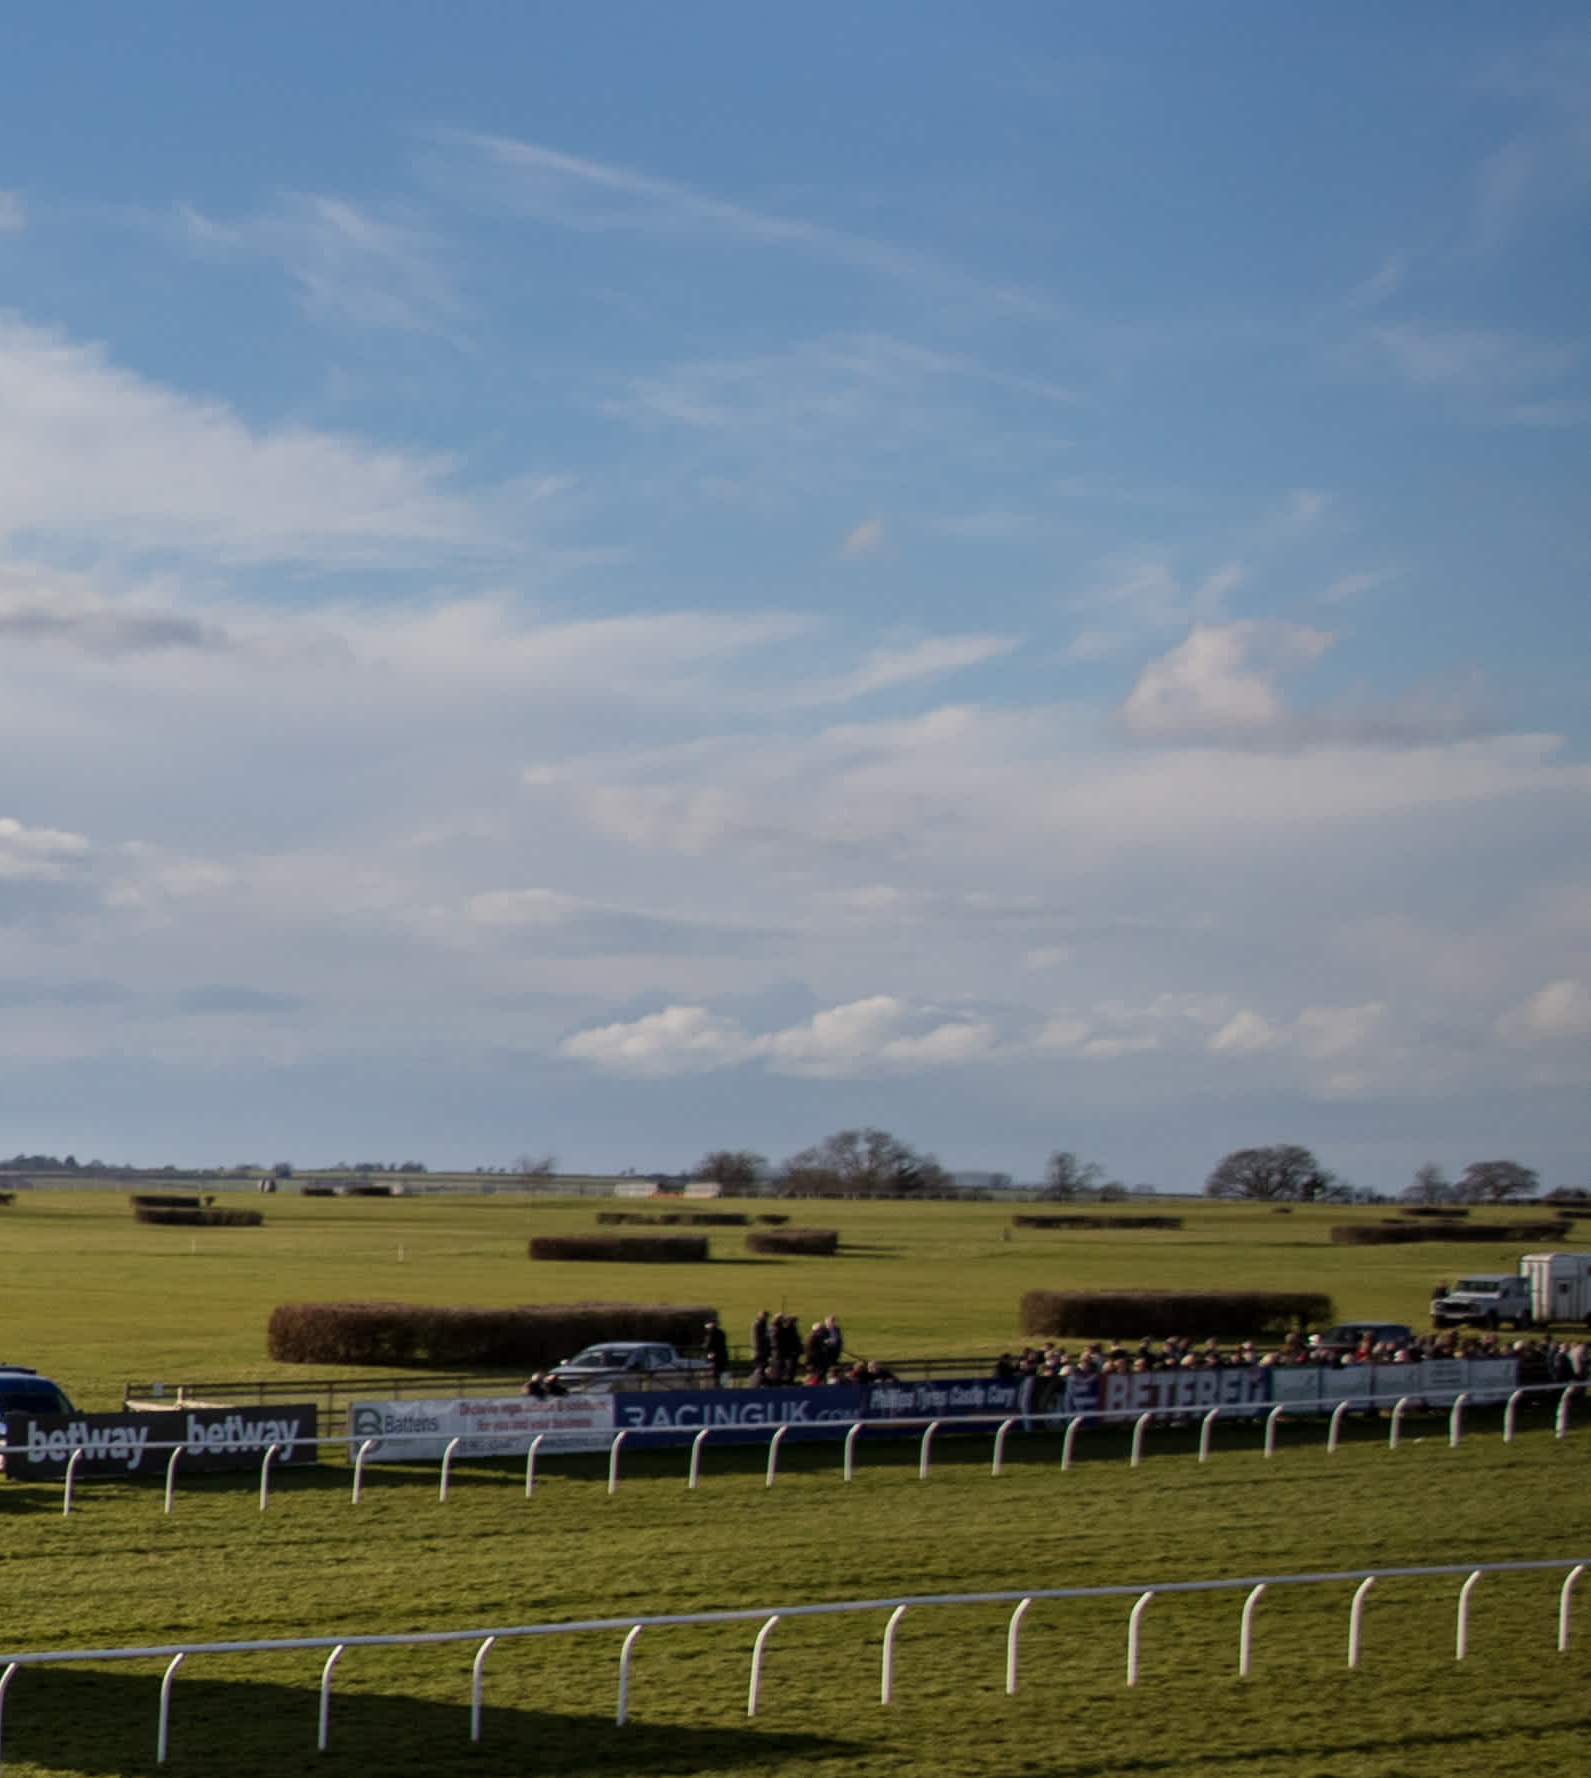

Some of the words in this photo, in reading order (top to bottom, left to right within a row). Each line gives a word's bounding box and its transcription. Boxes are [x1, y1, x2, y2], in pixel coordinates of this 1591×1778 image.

[28, 1420, 148, 1469] betway
[186, 1414, 300, 1461] betway
[384, 1415, 440, 1433] Battens
